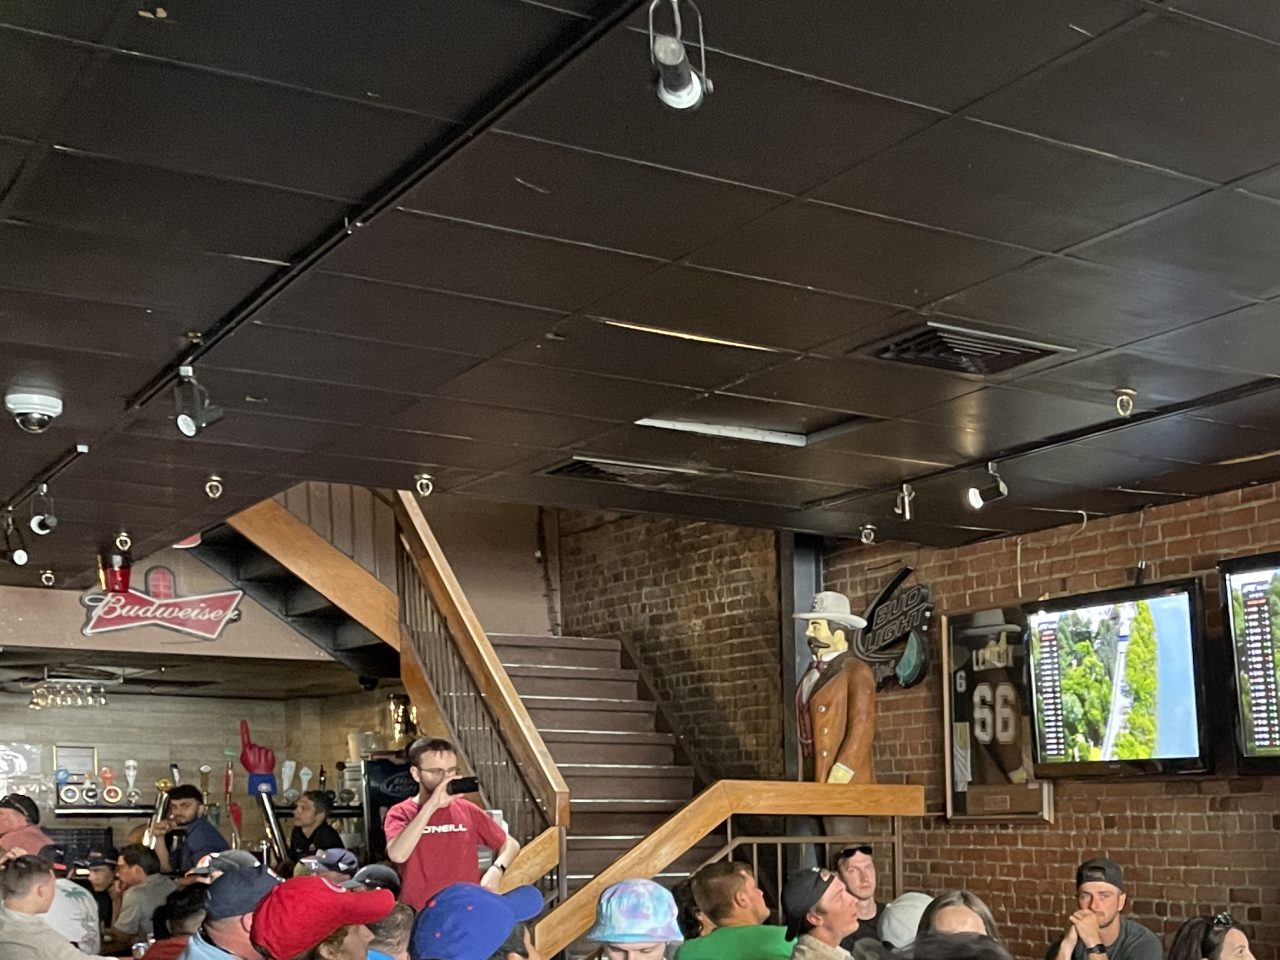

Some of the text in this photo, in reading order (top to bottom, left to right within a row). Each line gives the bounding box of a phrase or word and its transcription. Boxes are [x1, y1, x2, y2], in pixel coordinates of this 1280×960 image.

[85, 593, 239, 622] Budweiser
[864, 602, 927, 656] LIGHT
[873, 585, 922, 630] BUD
[973, 682, 1015, 745] 66
